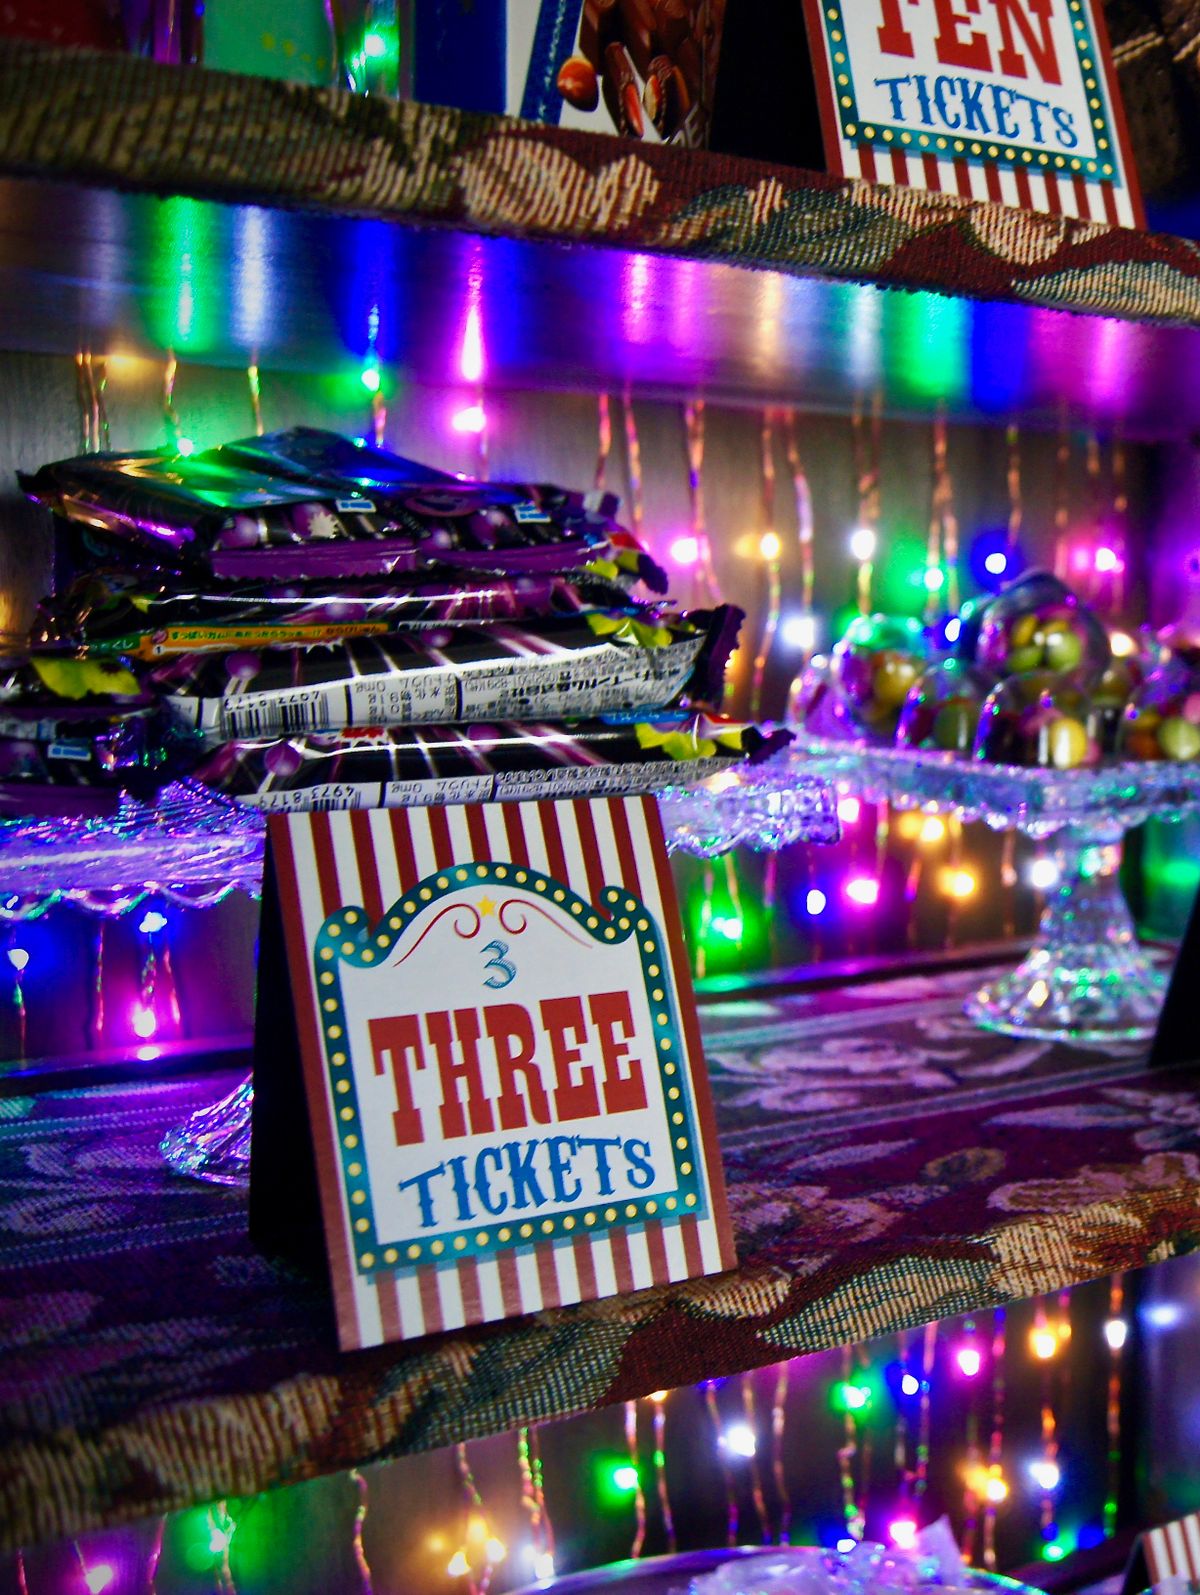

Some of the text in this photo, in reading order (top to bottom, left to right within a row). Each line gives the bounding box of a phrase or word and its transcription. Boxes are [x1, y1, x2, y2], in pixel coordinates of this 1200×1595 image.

[876, 0, 1063, 86] TEN
[874, 74, 1079, 148] TICKETS
[479, 939, 517, 989] 3
[367, 990, 649, 1147] THREE
[398, 1134, 657, 1228] TICKETS
